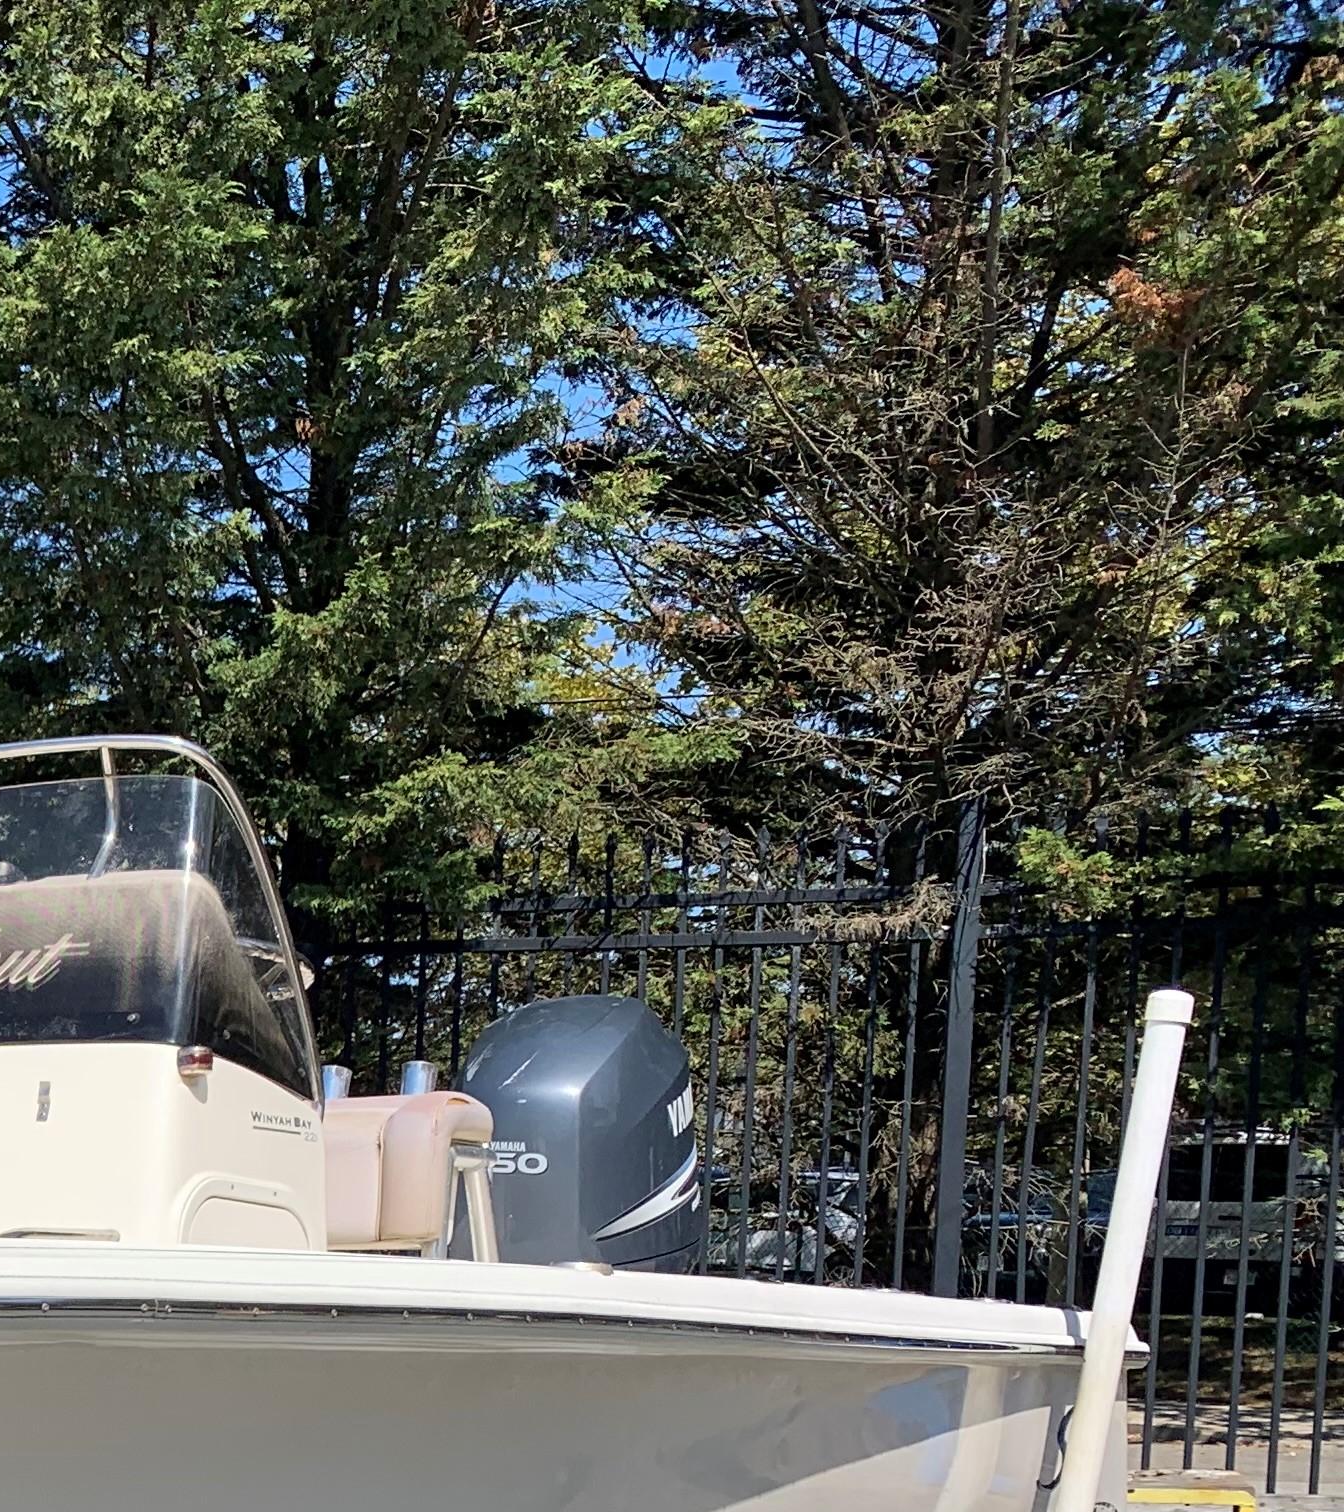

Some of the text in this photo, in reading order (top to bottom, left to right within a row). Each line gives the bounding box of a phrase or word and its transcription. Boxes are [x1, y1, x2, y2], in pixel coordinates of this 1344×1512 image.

[251, 1111, 312, 1129] WINYAH BAY
[490, 1141, 526, 1152] YAMAHA
